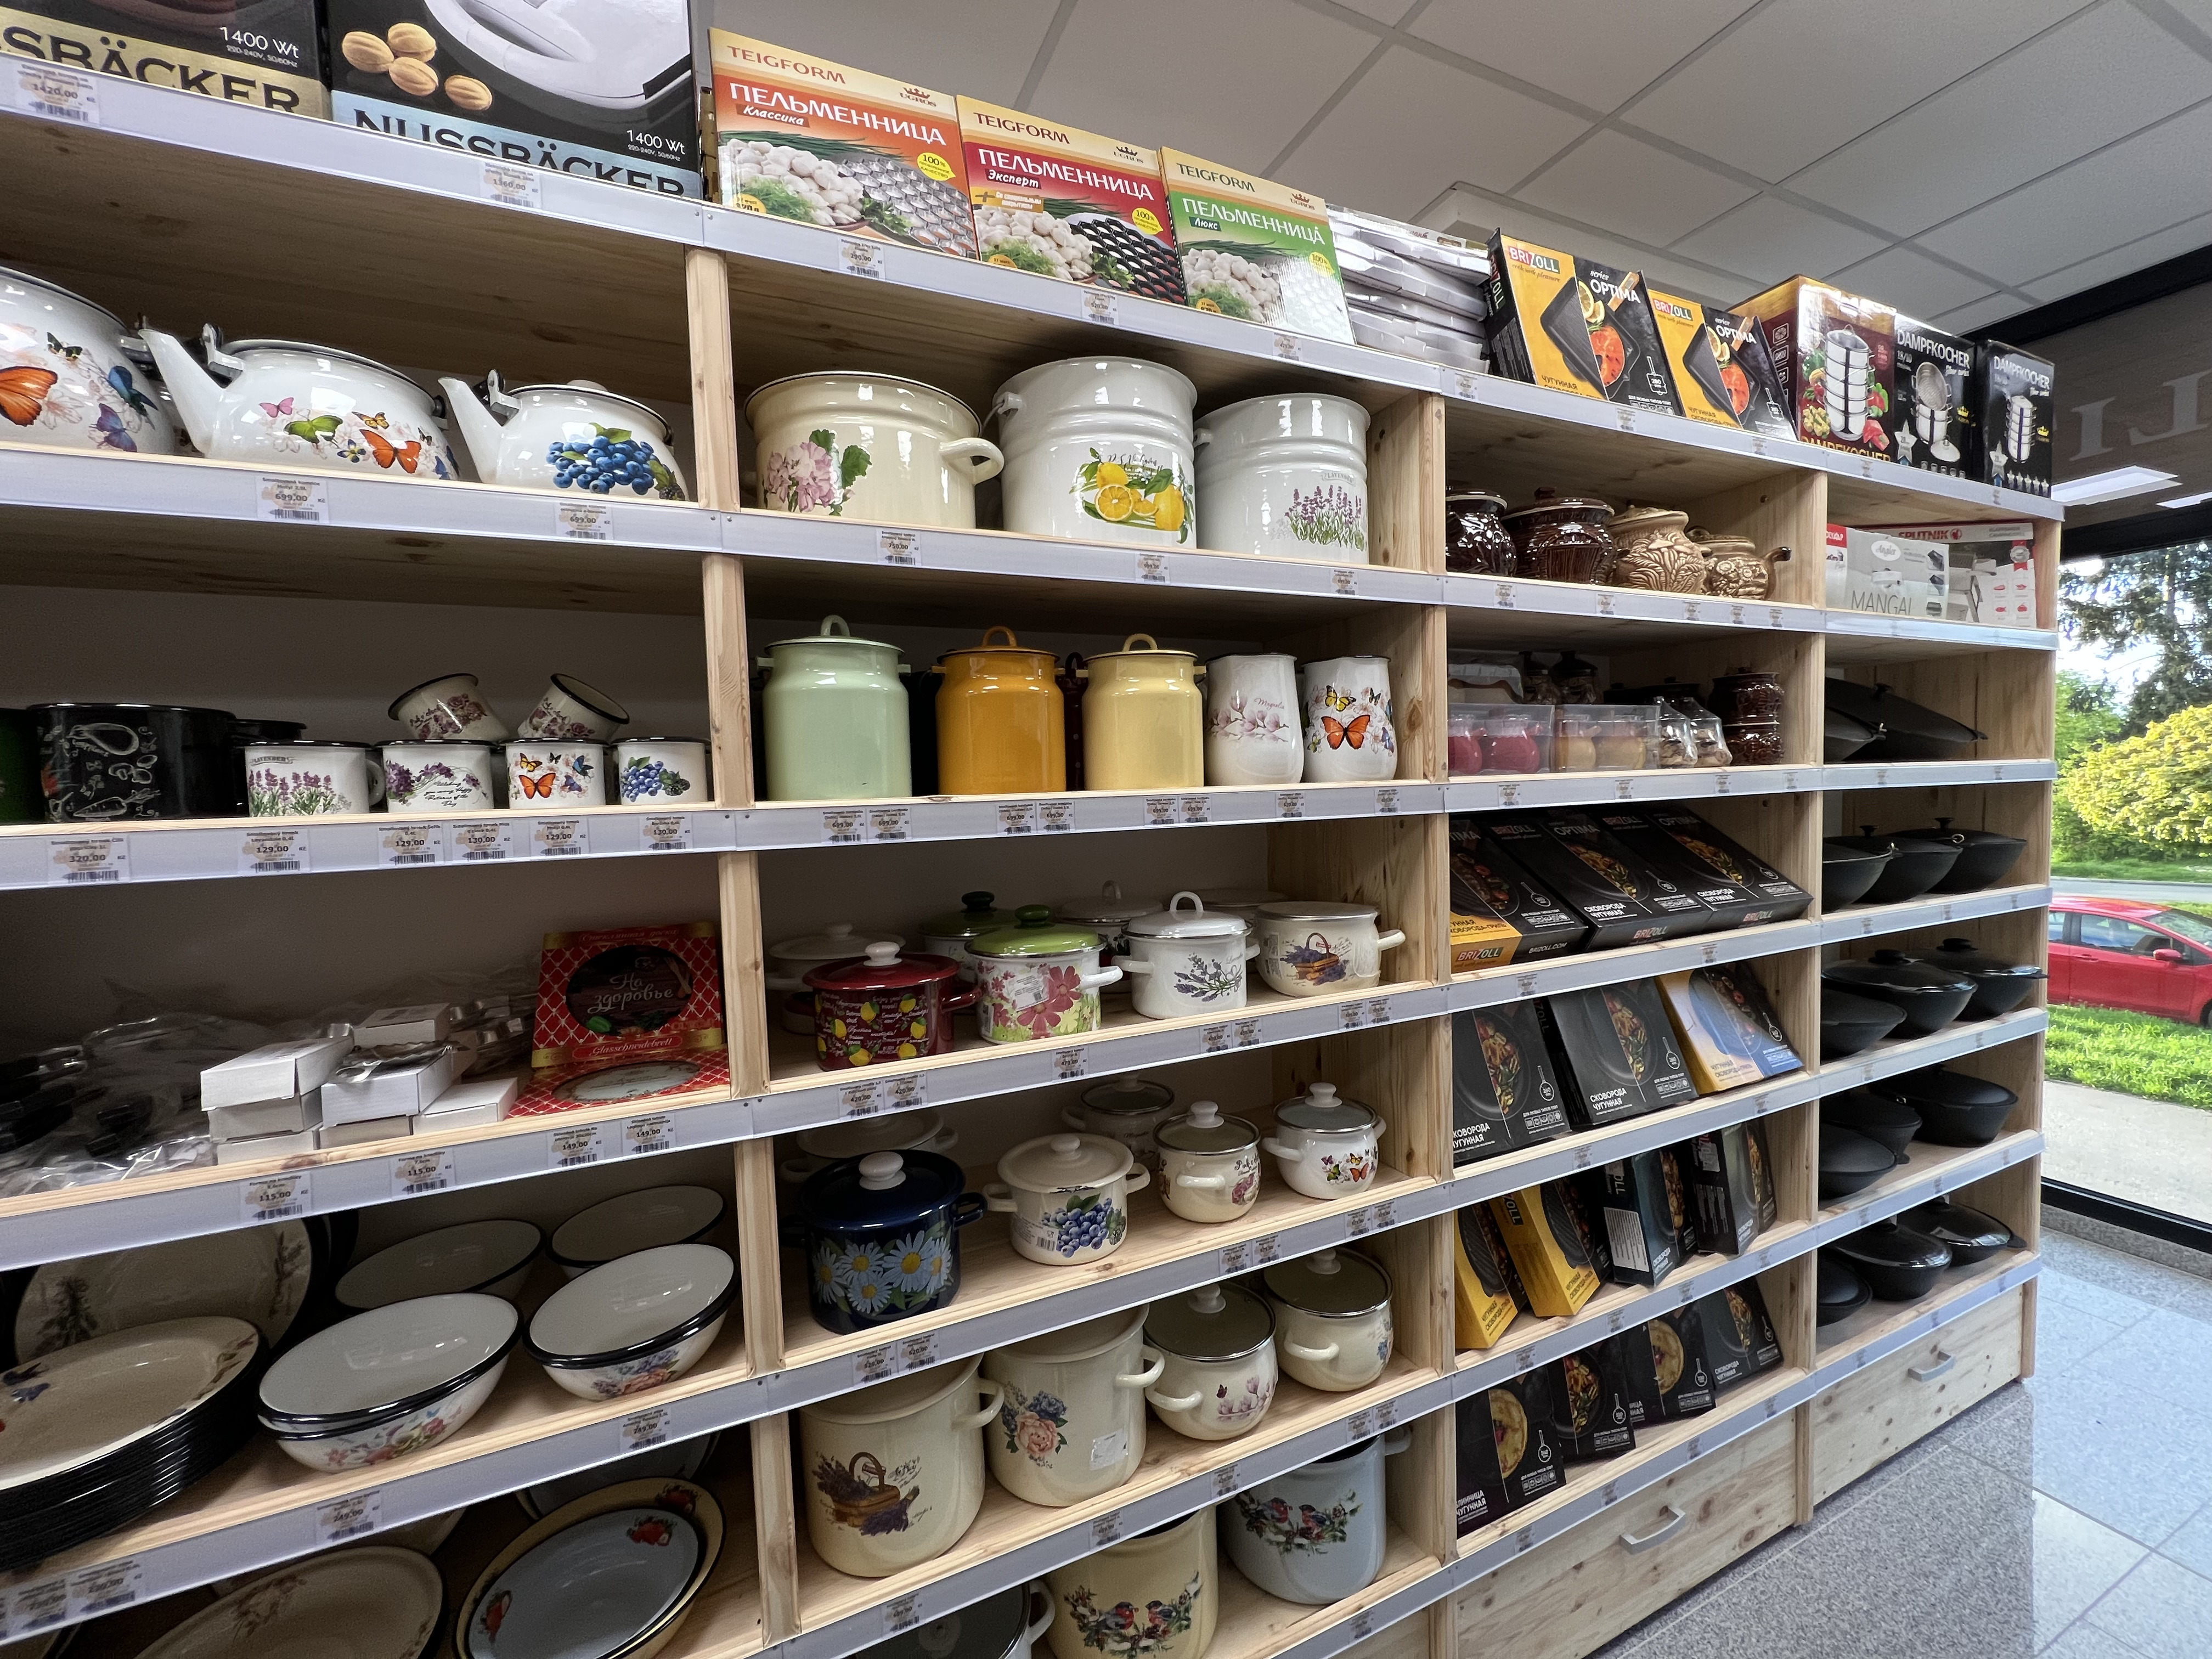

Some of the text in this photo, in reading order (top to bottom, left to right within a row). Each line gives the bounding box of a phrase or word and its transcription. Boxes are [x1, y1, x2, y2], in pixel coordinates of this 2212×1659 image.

[220, 26, 299, 59] 1400 Wt
[727, 45, 846, 84] TEIGFORM
[729, 82, 947, 146] ПЕЛЬМЕННИЦА
[742, 105, 805, 126] Классика
[973, 112, 1070, 144] TEIGFORM
[627, 129, 685, 155] 1400 Wt
[978, 148, 1154, 201] ПЕЛЬМЕННИЦА
[988, 168, 1040, 189] Эксперт
[1176, 163, 1255, 193] TEIGFORM
[1182, 198, 1325, 246] ПЕЛЬМЕННИЦА
[1194, 217, 1218, 231] Люкс
[1509, 246, 1559, 273] BRIZOLL
[1590, 278, 1641, 304] OPTIMA
[1654, 299, 1692, 320] BRIZOLL
[1716, 325, 1757, 345] OPTIMA
[1897, 329, 1971, 369] DAMPFKOCHER
[1994, 355, 2050, 391] DAMPFKOCHER
[1898, 529, 1949, 541] SPUTNIK
[394, 839, 425, 847] 129,00
[1449, 831, 1481, 841] TIMA
[69, 854, 106, 863] 320,00
[256, 845, 289, 853] 129,00
[1449, 919, 1476, 928] УННАЯ
[1633, 926, 1667, 939] BRIZOLL
[1457, 947, 1500, 961] BRIZOLL
[609, 972, 644, 992] На
[586, 983, 675, 1015] здоровье
[1589, 1087, 1628, 1103] СКОВОРОДА
[1592, 1097, 1624, 1111] ЧУГУННАЯ
[636, 1128, 661, 1138] 149,00
[1453, 1122, 1491, 1139] КОВОРОДА
[562, 1141, 588, 1151] 149,00
[408, 1166, 437, 1177] 115,00
[259, 1191, 291, 1203] 115,00
[1503, 1194, 1518, 1224] ZOLL
[1457, 1489, 1485, 1508] ЛИННИЦА
